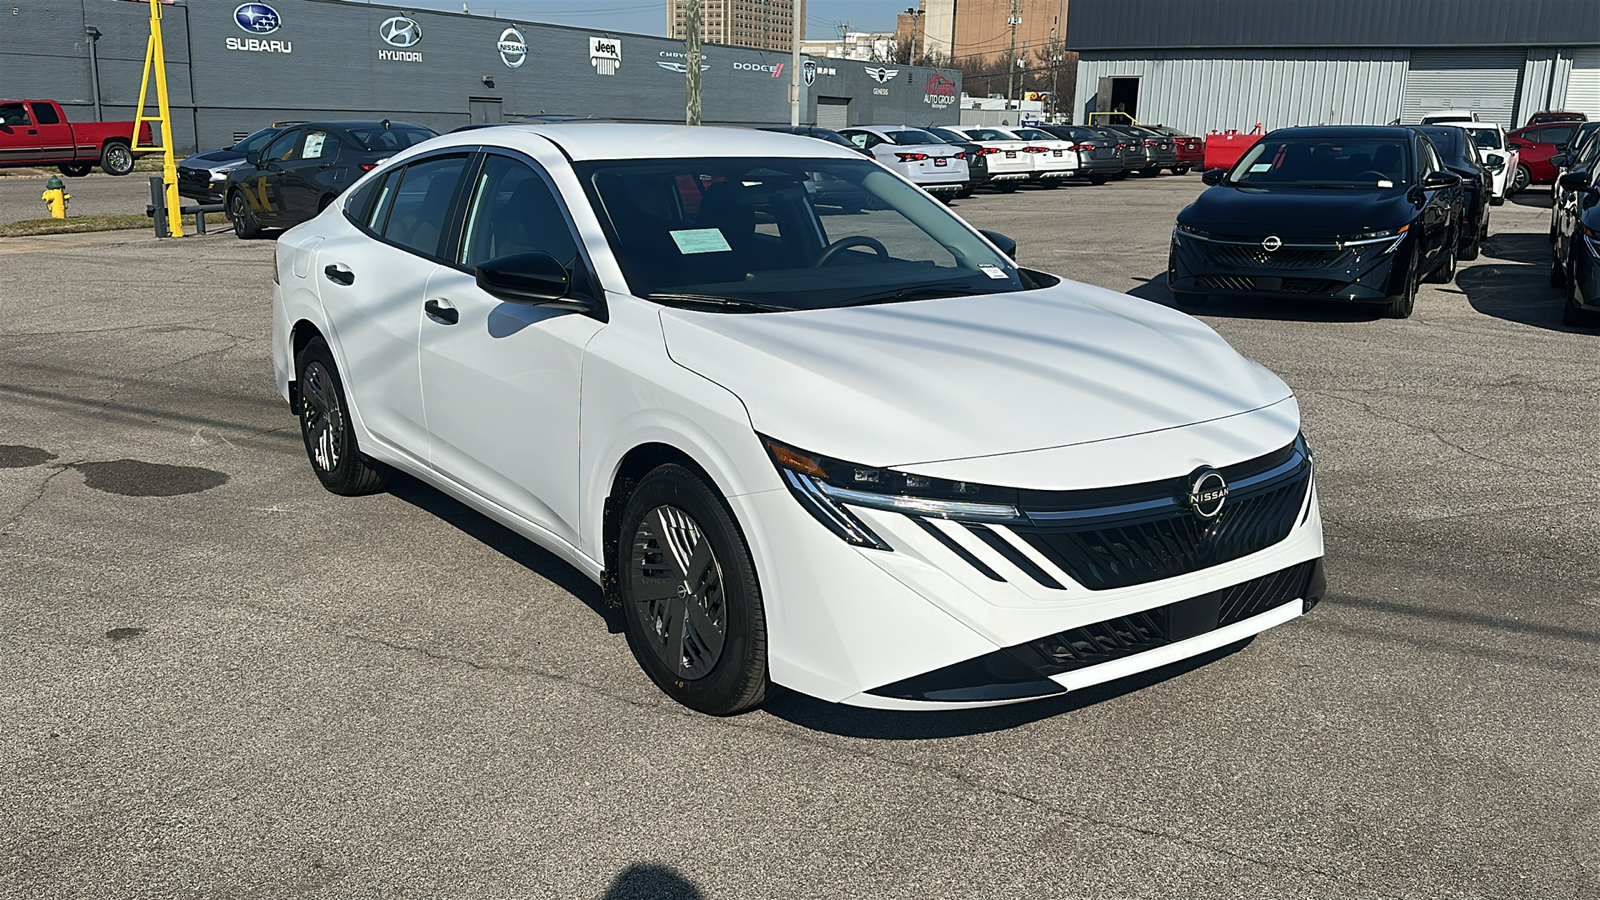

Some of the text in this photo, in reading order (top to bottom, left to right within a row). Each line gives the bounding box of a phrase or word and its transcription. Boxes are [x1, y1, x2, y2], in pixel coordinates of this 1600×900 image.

[225, 37, 292, 54] SUBARU
[500, 43, 525, 53] NISSAN
[595, 40, 616, 56] Jeep
[378, 50, 423, 62] HYUNDAI
[660, 51, 706, 60] CHRYR
[733, 62, 778, 73] DODGE
[817, 67, 836, 76] RAM
[924, 95, 955, 104] AUTO GROUP
[1191, 488, 1229, 502] NISSAN
